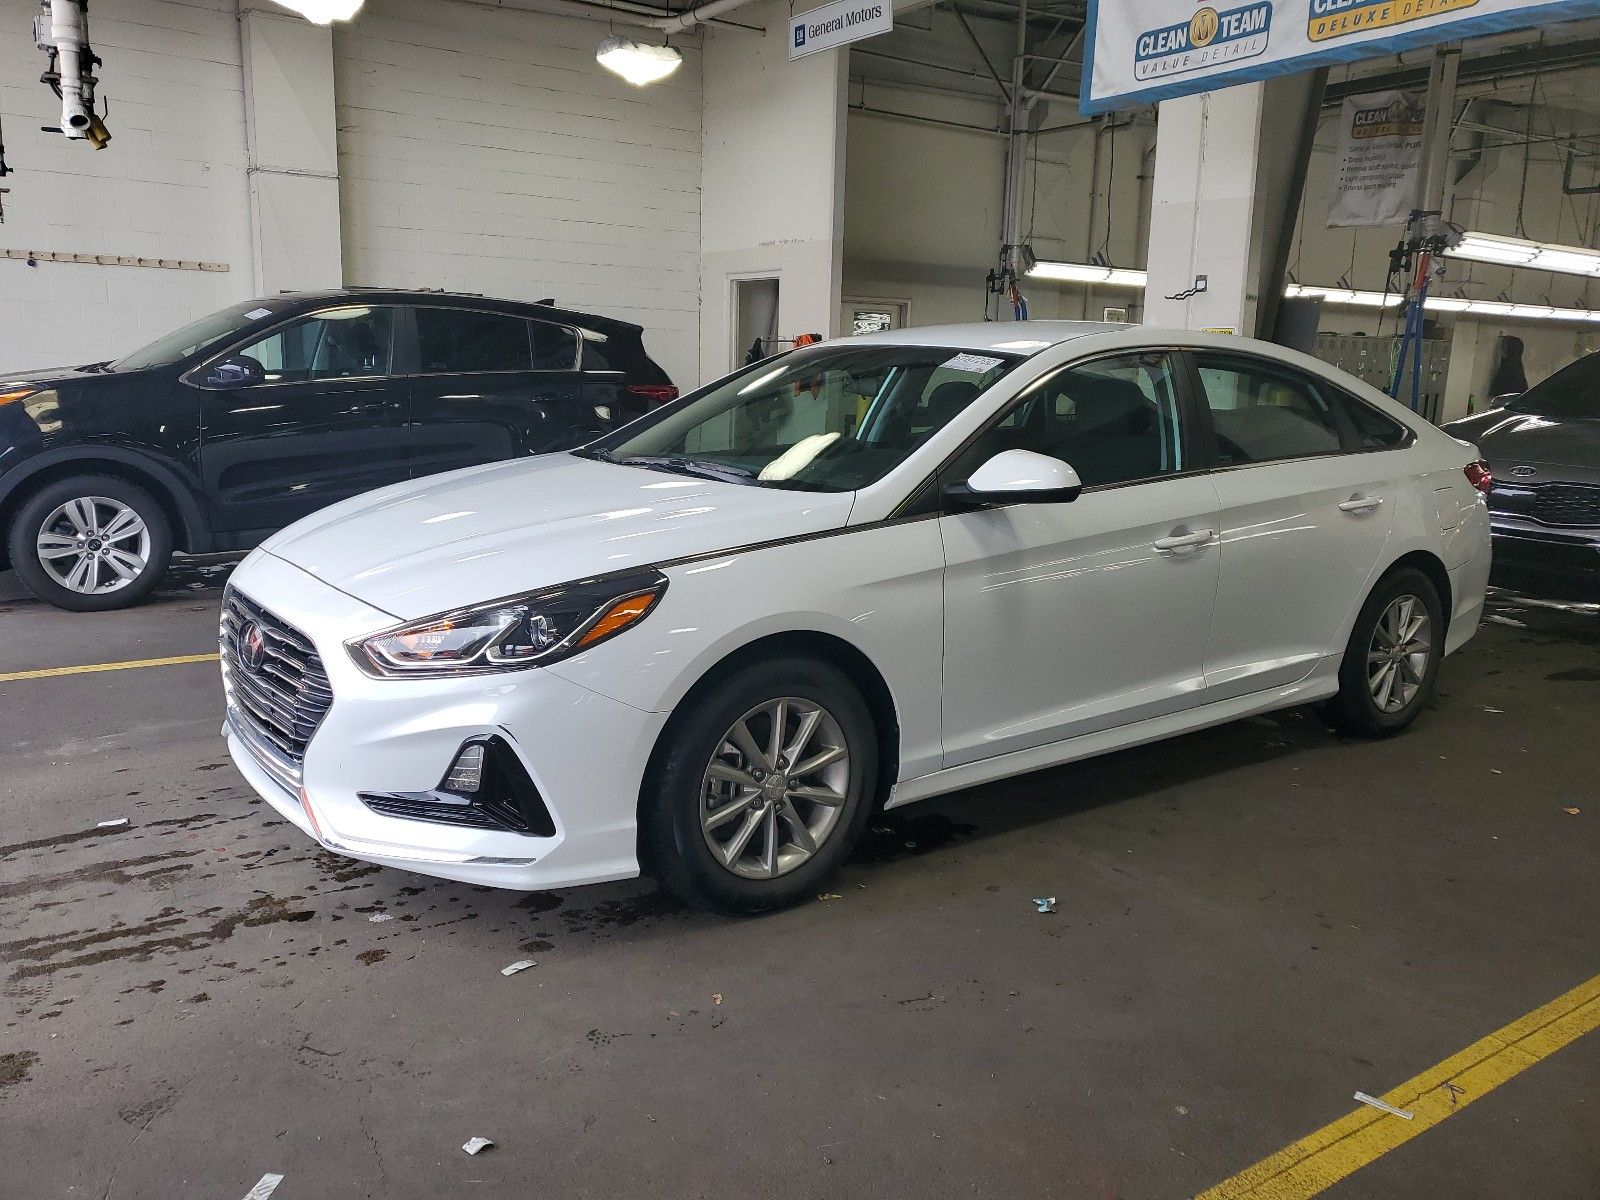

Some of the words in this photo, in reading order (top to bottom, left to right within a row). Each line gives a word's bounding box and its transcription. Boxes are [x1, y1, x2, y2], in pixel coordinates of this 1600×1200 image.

[808, 15, 843, 38] General
[846, 5, 882, 27] Motors
[1139, 26, 1188, 57] CLEAN
[1220, 5, 1267, 38] TEAM
[1317, 8, 1390, 35] DELUXE
[1142, 56, 1190, 75] VALUE
[1201, 39, 1257, 62] DETAIL
[1355, 109, 1388, 125] CLEAN
